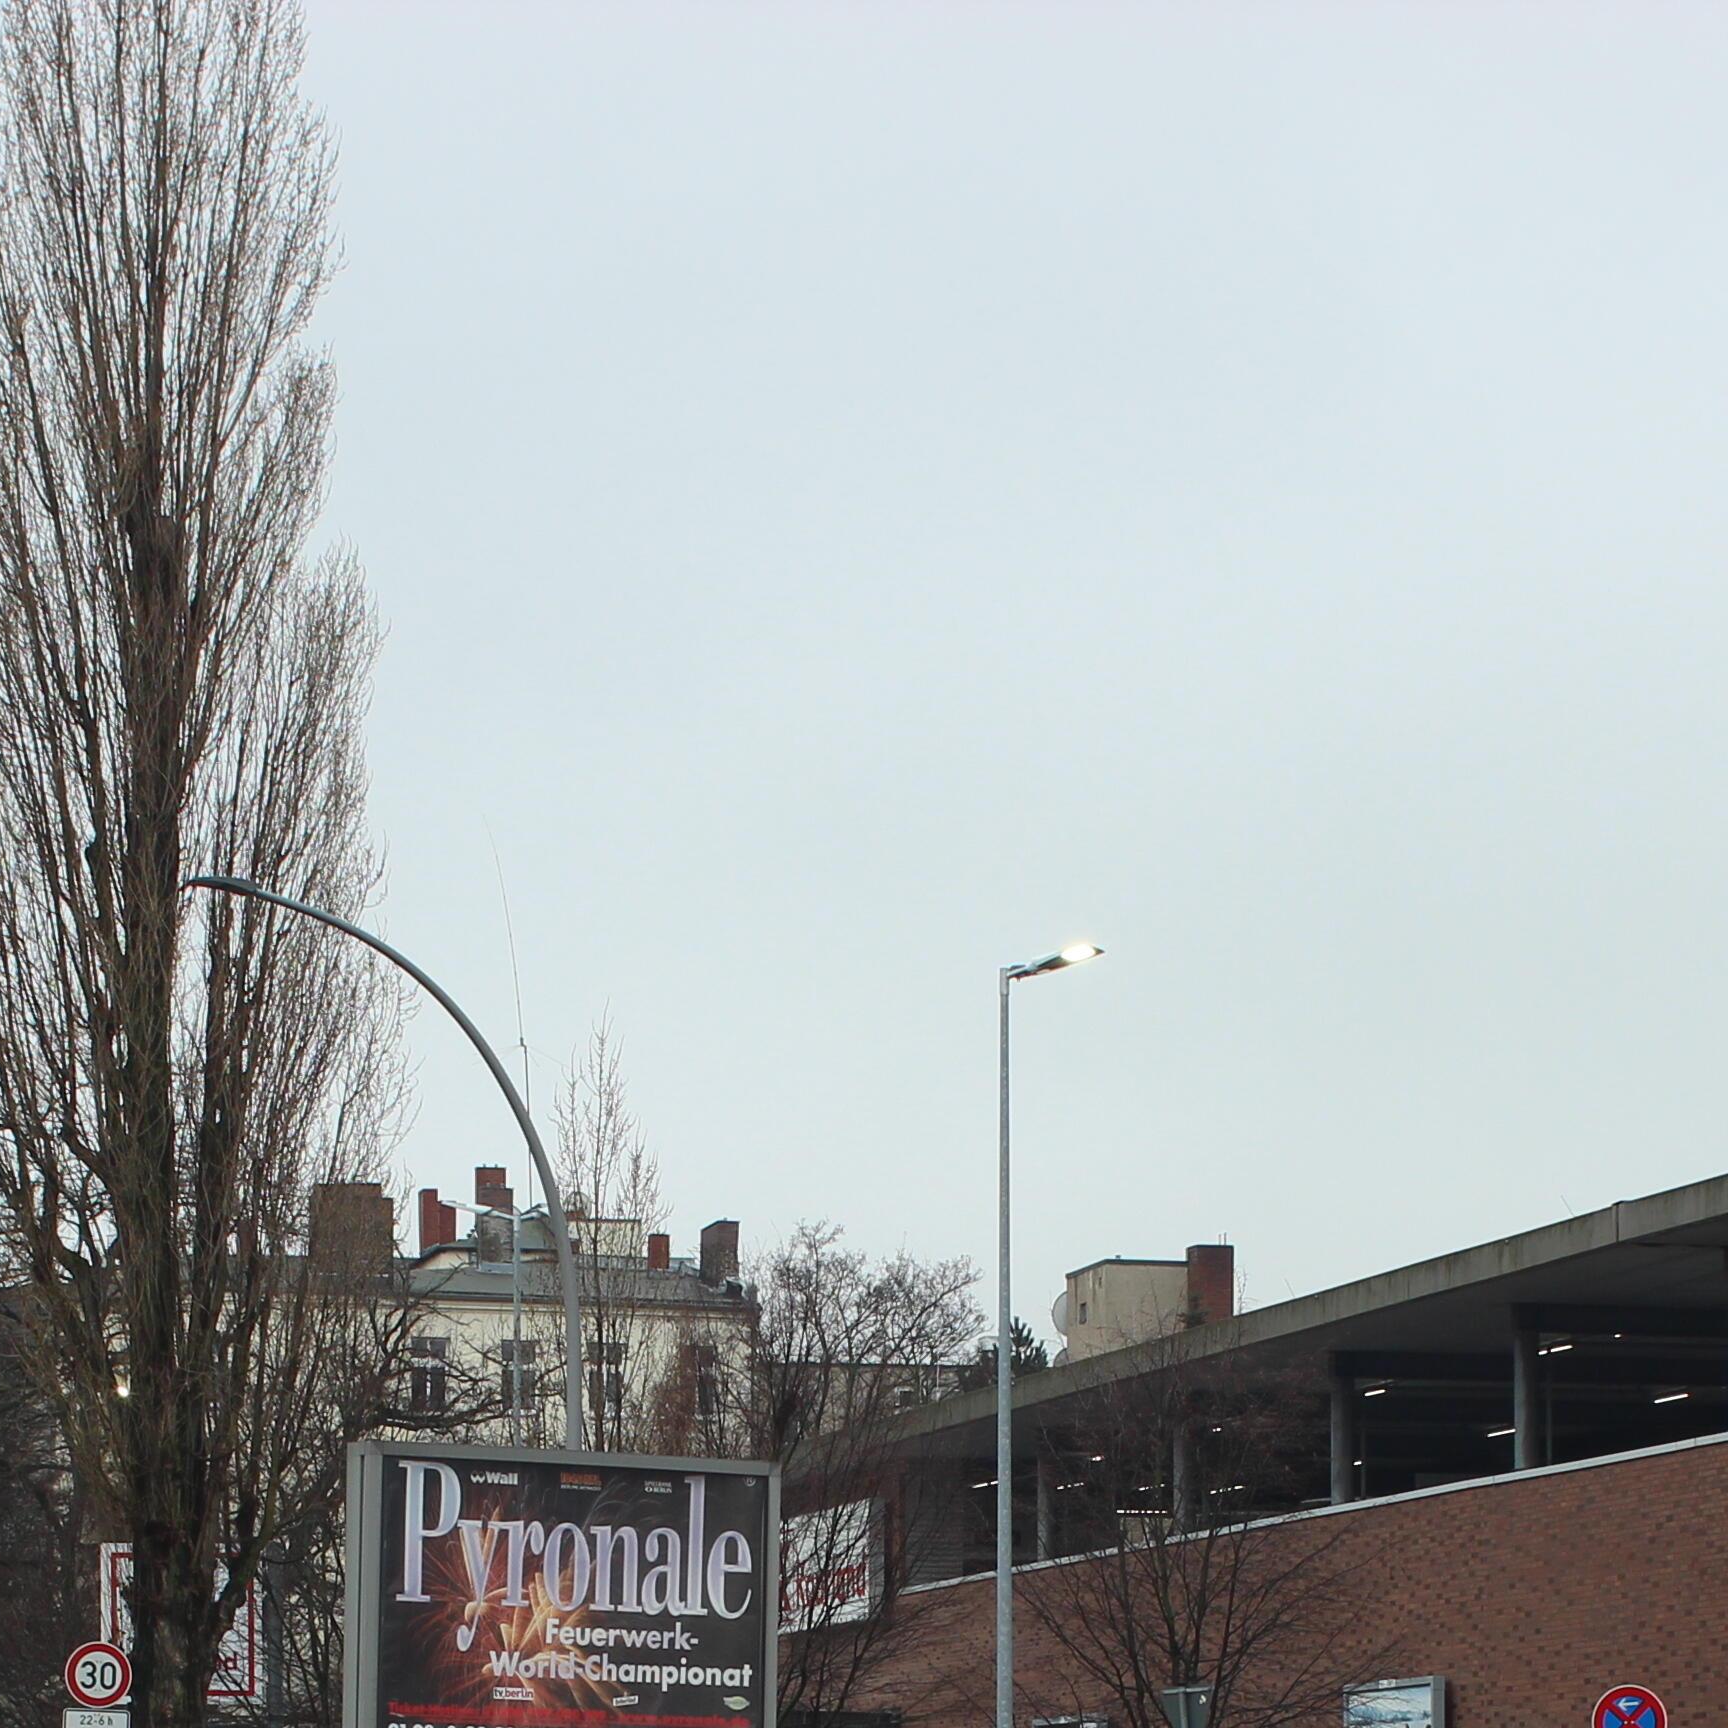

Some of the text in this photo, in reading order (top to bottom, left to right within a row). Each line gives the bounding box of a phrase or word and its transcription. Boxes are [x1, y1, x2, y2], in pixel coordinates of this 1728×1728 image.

[486, 1471, 518, 1486] Wall
[395, 1459, 752, 1652] Pyronale
[545, 1617, 699, 1651] Feuerwerk-
[80, 1660, 117, 1690] 30
[490, 1650, 753, 1692] World-Championat
[79, 1714, 113, 1726] 22-6 h
